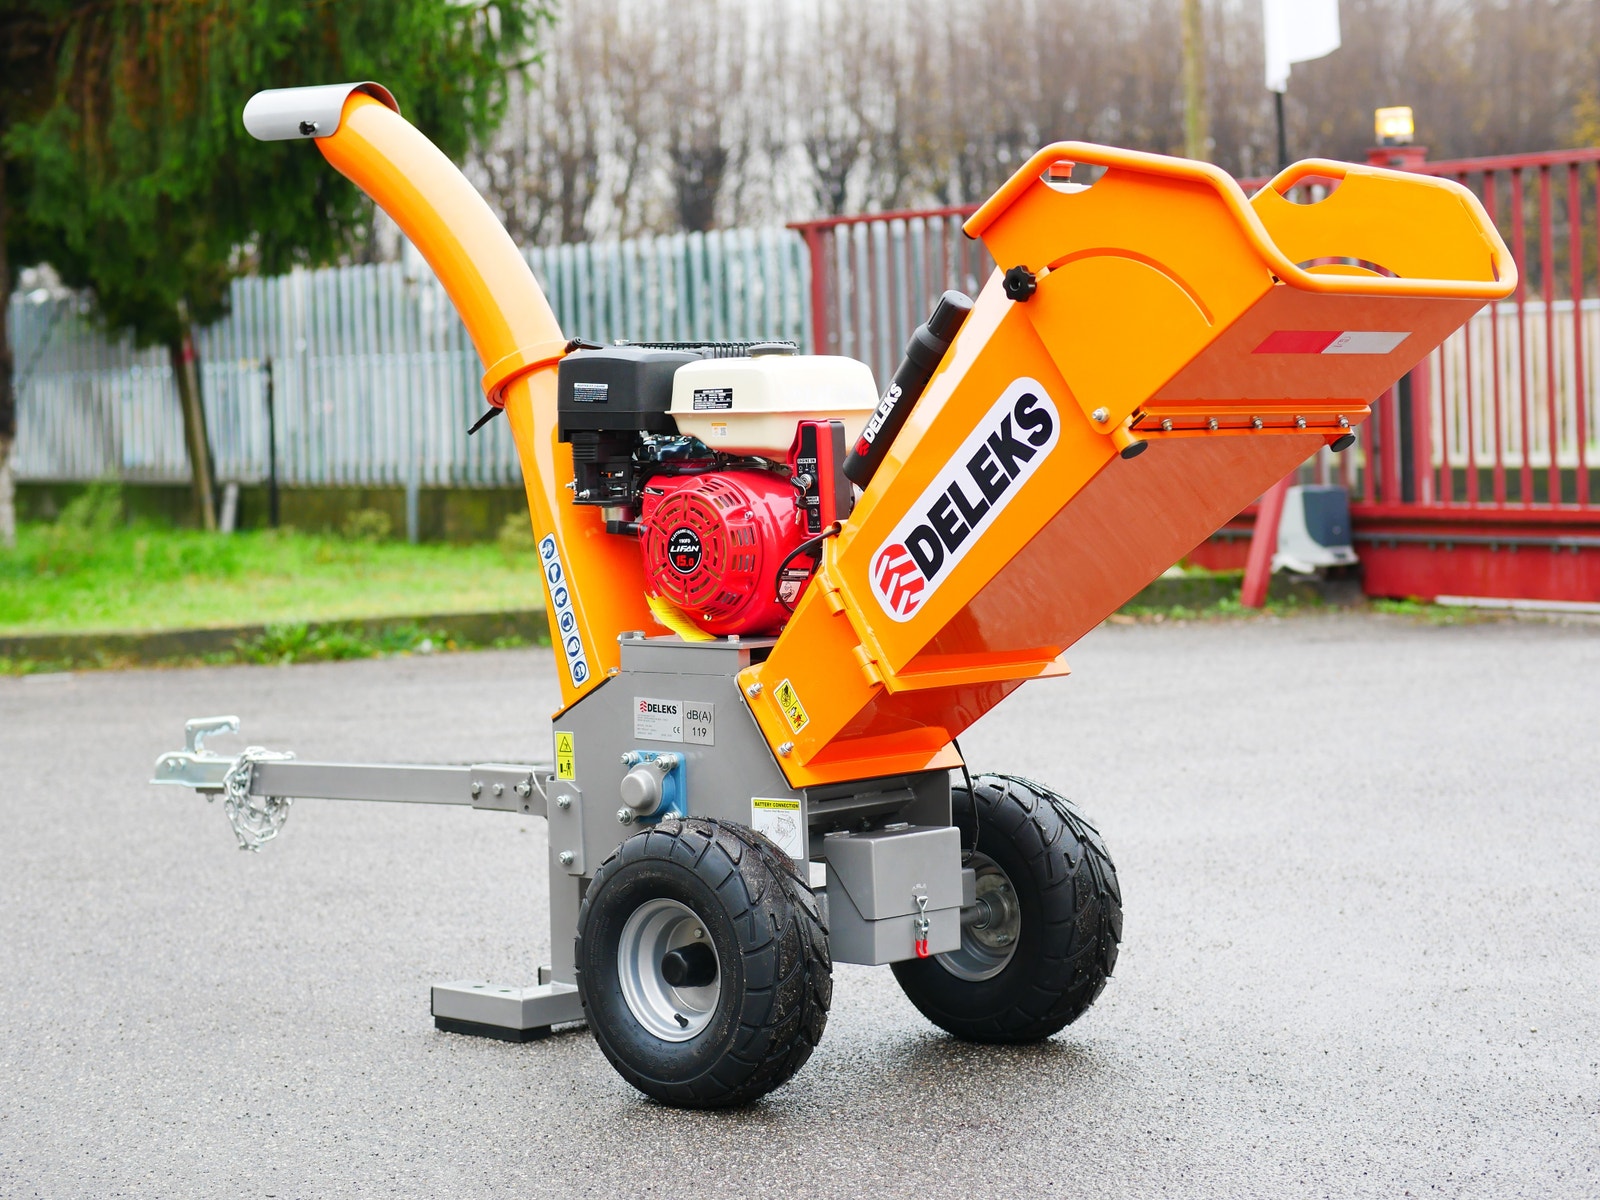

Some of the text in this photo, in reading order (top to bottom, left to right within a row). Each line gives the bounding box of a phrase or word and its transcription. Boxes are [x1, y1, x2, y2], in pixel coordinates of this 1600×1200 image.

[863, 382, 902, 443] DELEKS
[904, 393, 1053, 582] DELEKS
[670, 545, 700, 553] LIFAN
[676, 555, 695, 567] 15.0
[647, 703, 678, 715] DELEKS
[686, 710, 712, 724] dB(A)
[692, 727, 707, 738] 119
